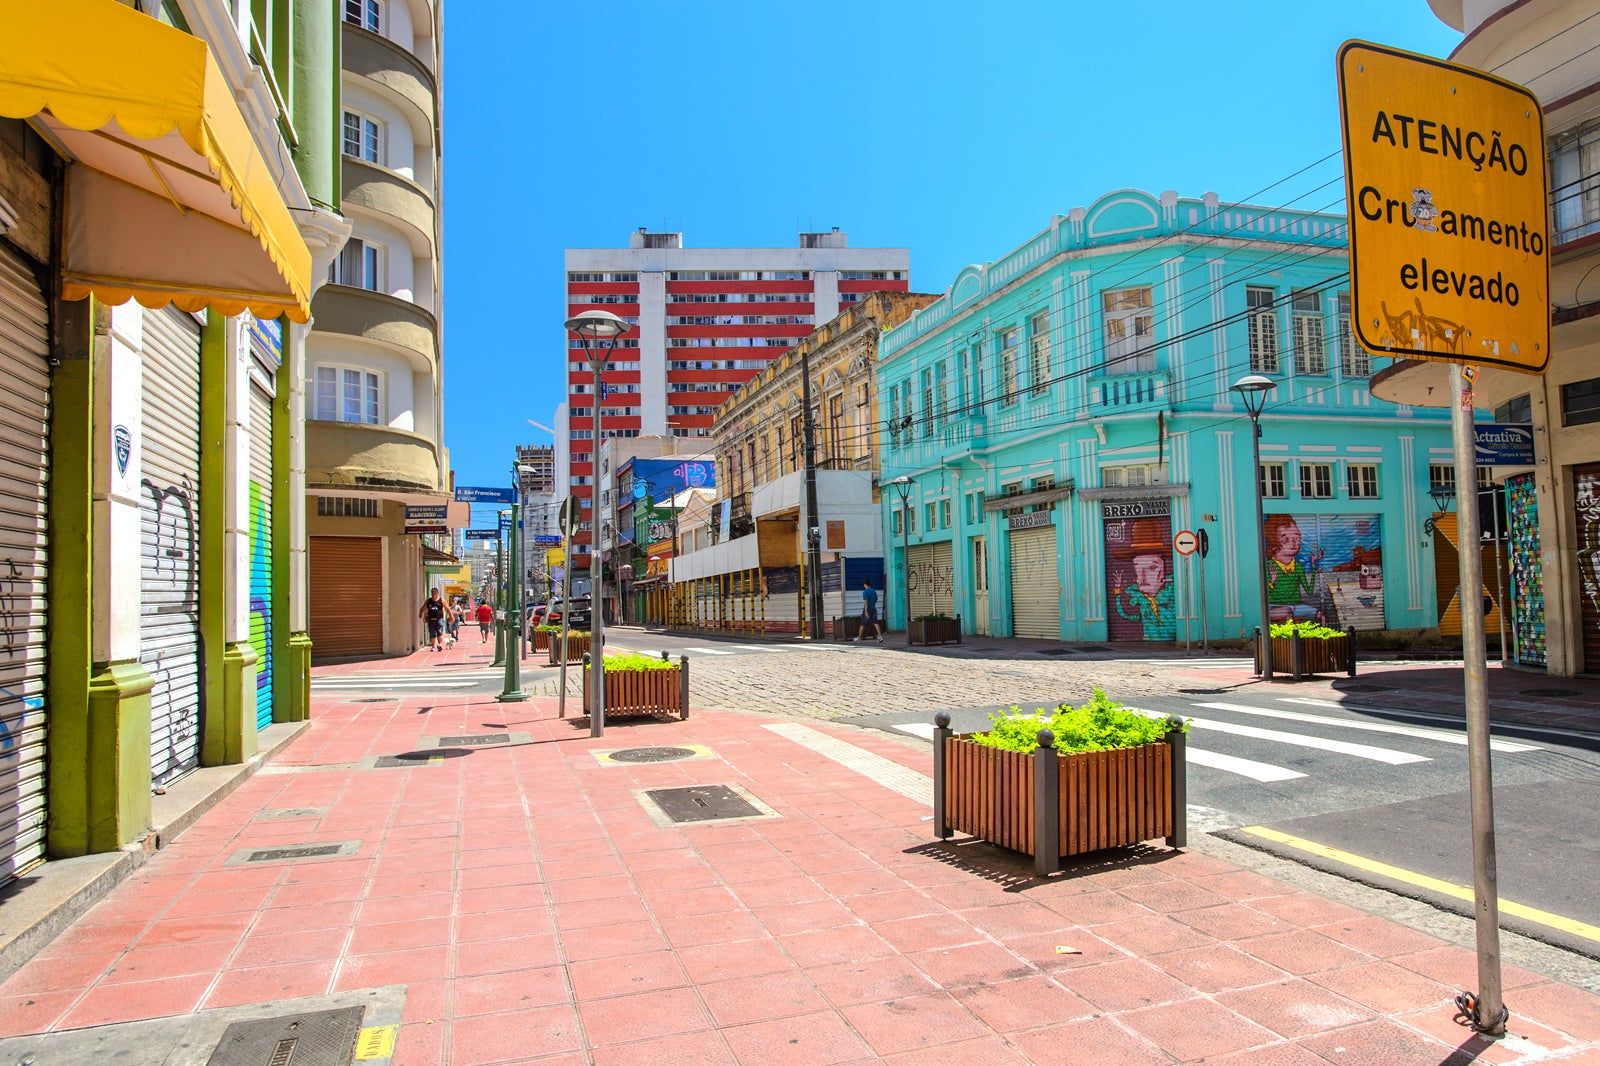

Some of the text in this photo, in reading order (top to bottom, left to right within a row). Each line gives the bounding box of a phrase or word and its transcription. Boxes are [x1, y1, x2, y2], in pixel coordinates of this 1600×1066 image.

[1371, 110, 1528, 177] ATENÇÃO
[1358, 185, 1544, 257] Cruamento
[1400, 257, 1520, 307] elevado
[1104, 501, 1144, 517] BREXÓ
